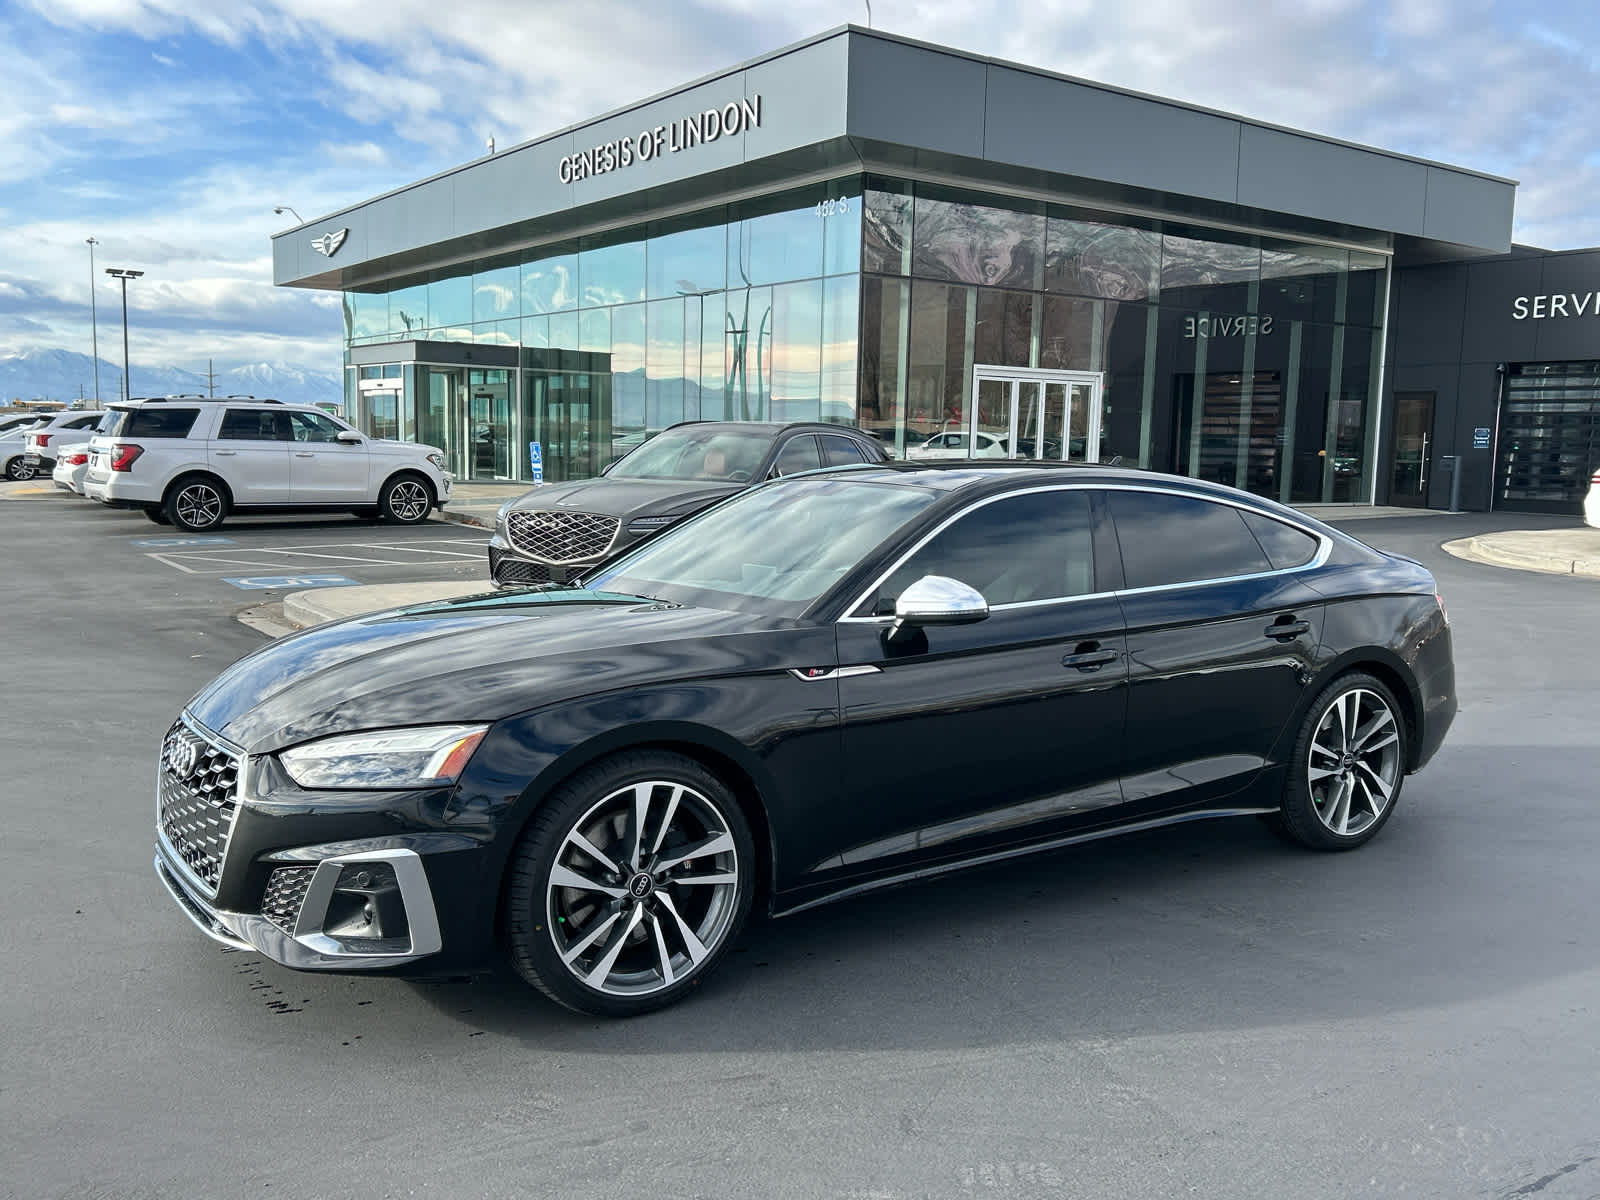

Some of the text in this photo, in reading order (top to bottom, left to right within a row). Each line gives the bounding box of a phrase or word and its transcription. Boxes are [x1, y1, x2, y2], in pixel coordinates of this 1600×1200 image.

[559, 95, 761, 184] GENESIS OF LINDON
